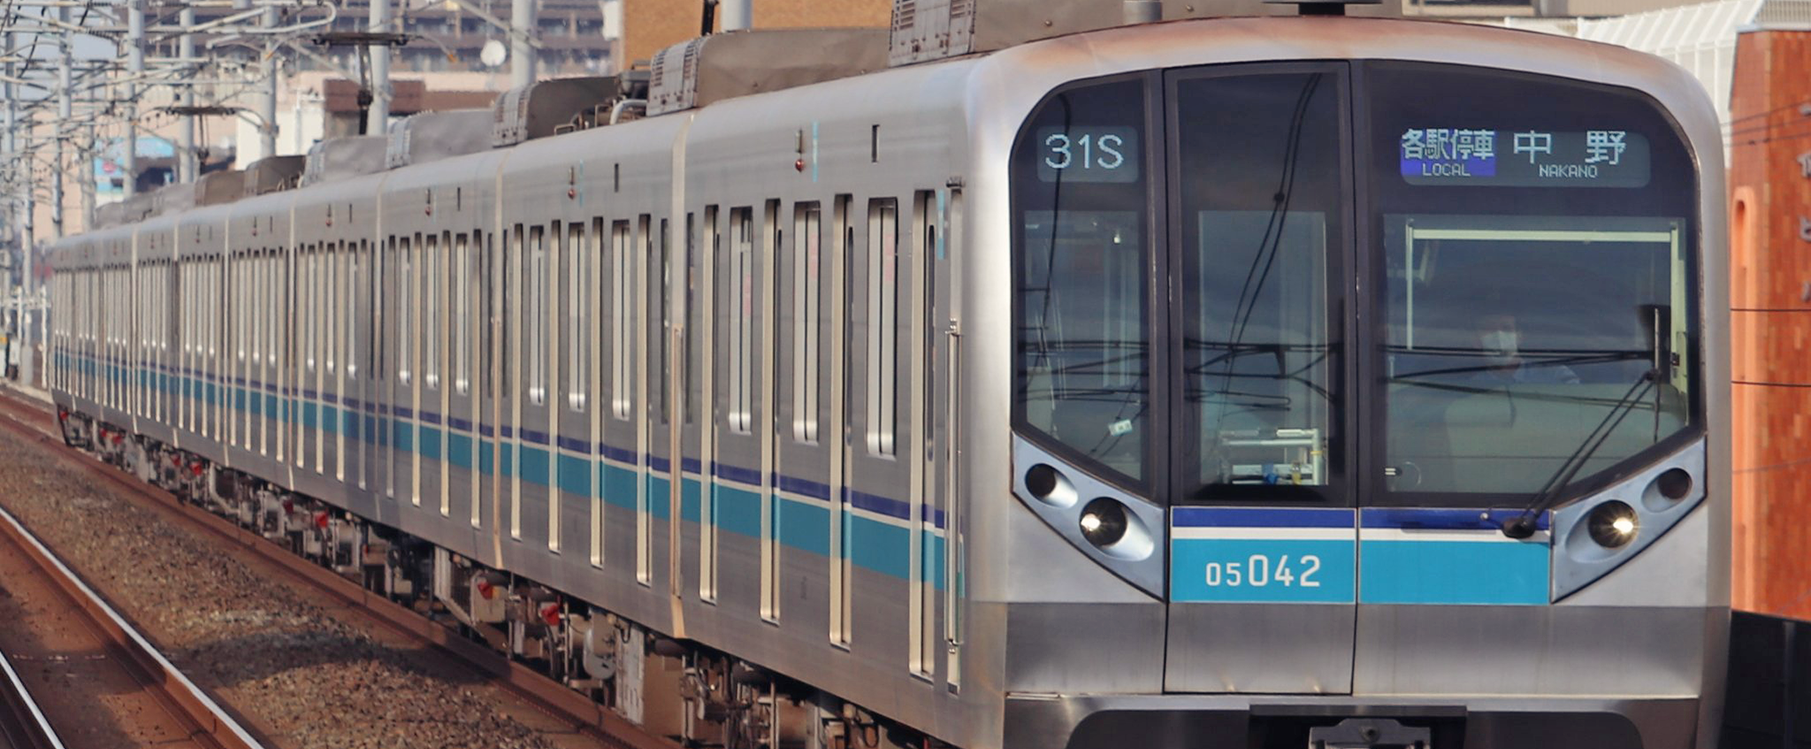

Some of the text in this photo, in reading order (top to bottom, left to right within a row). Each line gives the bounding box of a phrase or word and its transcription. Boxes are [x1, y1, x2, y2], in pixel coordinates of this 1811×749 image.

[1045, 133, 1124, 169] 31S
[1401, 128, 1495, 160] 各駅停車
[1422, 163, 1471, 177] LOCAL
[1539, 164, 1598, 179] NAKANO
[1205, 554, 1320, 587] 05042
